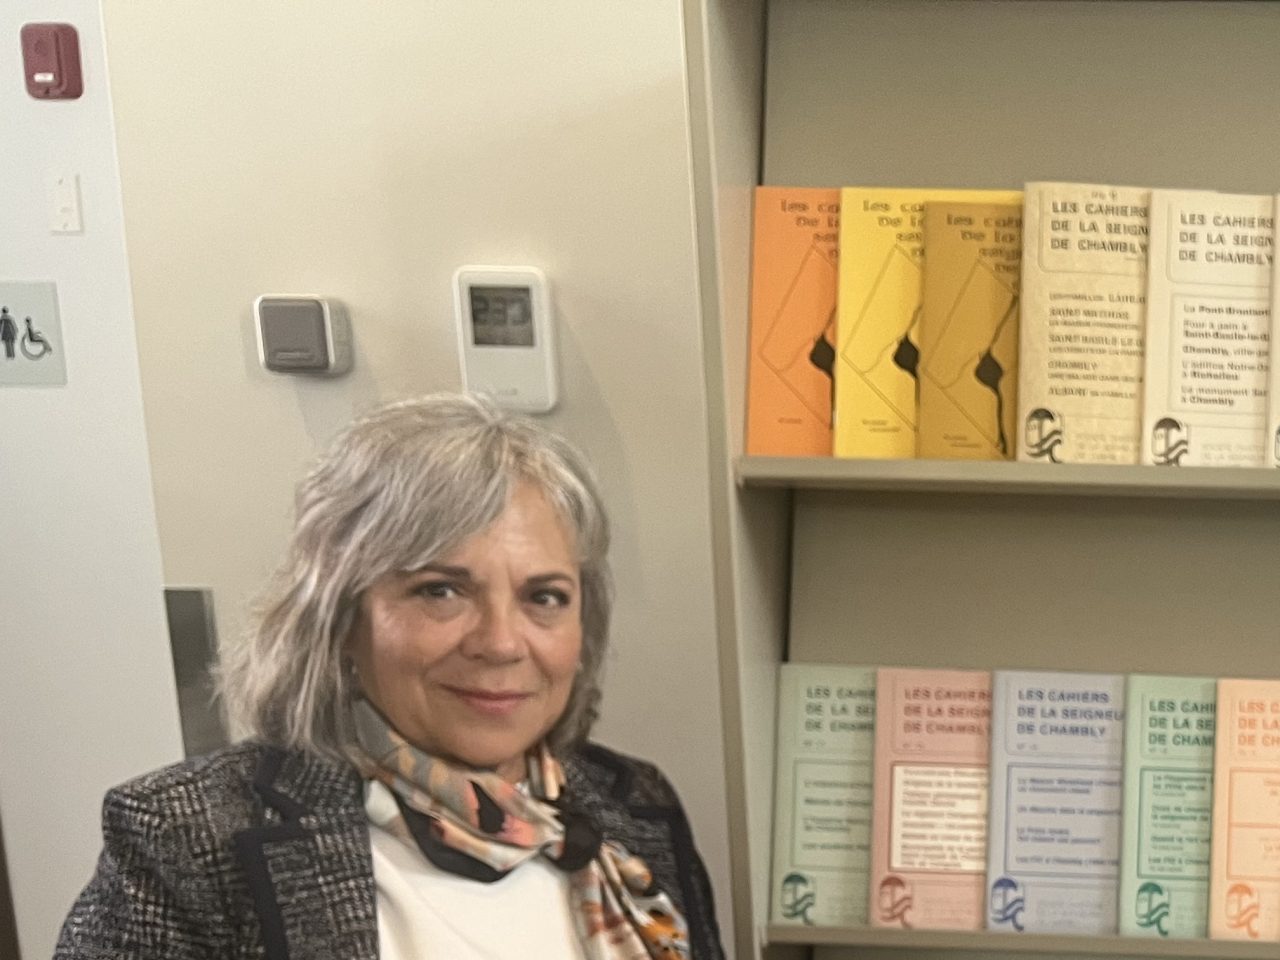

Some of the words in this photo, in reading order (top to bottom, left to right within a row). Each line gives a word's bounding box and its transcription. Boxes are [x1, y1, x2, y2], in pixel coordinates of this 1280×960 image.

[1051, 201, 1077, 213] LES
[1085, 203, 1148, 217] CAHIERS
[1051, 220, 1069, 232] DE
[1079, 221, 1098, 233] LA
[1180, 214, 1206, 226] LES
[1213, 215, 1274, 229] CAHIERS
[1051, 239, 1069, 251] DE
[1179, 232, 1197, 244] DE
[1207, 233, 1225, 245] LA
[1178, 251, 1197, 262] DE
[1018, 689, 1044, 702] LES
[1048, 690, 1110, 703] CAHIERS
[1017, 707, 1035, 719] DE
[1040, 708, 1059, 720] LA
[1149, 701, 1176, 713] LES
[1239, 702, 1265, 713] LES
[1149, 717, 1167, 729] DE
[1172, 718, 1191, 730] LA
[1238, 717, 1257, 729] DE
[1262, 718, 1280, 730] LA
[1017, 723, 1035, 735] DE
[1040, 724, 1107, 738] CHAMBLY
[1148, 734, 1167, 746] DE
[1238, 735, 1257, 746] DE
